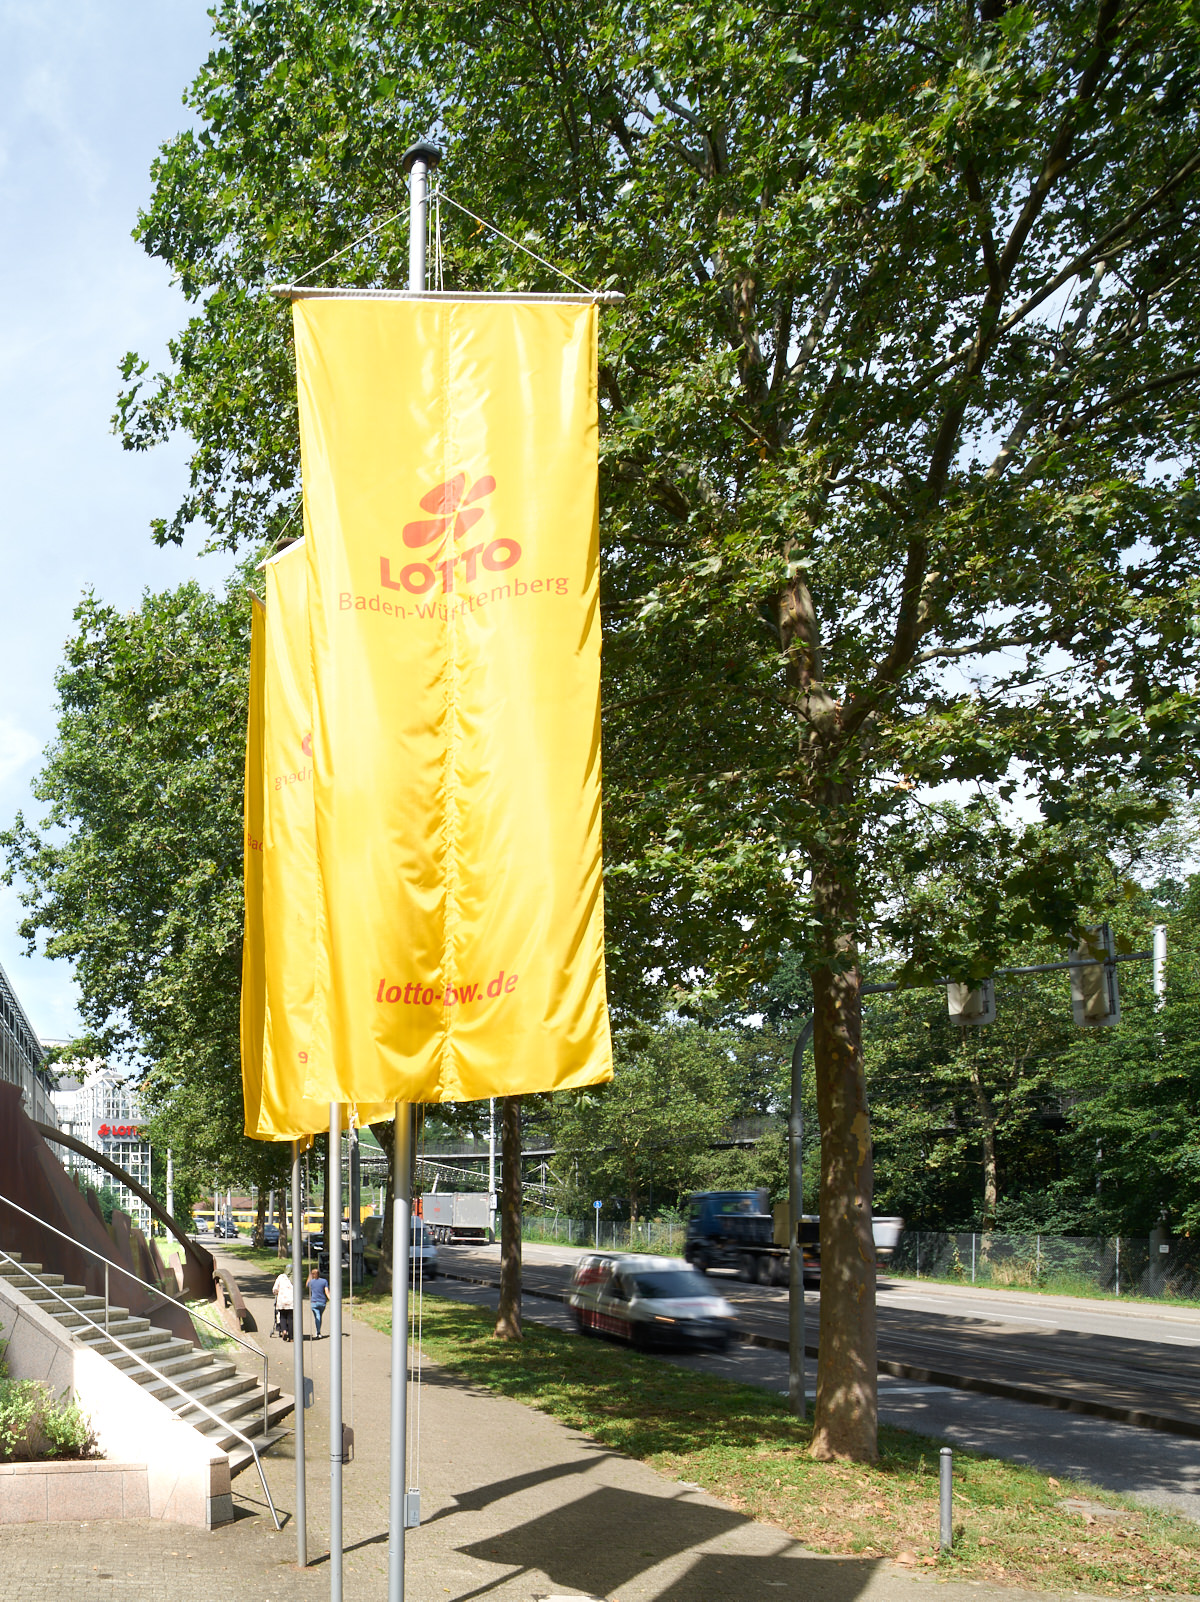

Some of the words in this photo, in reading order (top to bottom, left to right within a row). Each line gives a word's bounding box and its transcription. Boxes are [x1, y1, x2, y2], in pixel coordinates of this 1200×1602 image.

[380, 538, 522, 595] LOTTO
[339, 576, 570, 622] Baden-Württemberg
[376, 970, 519, 1007] lotto-bw.de
[112, 1125, 146, 1136] LOTT
